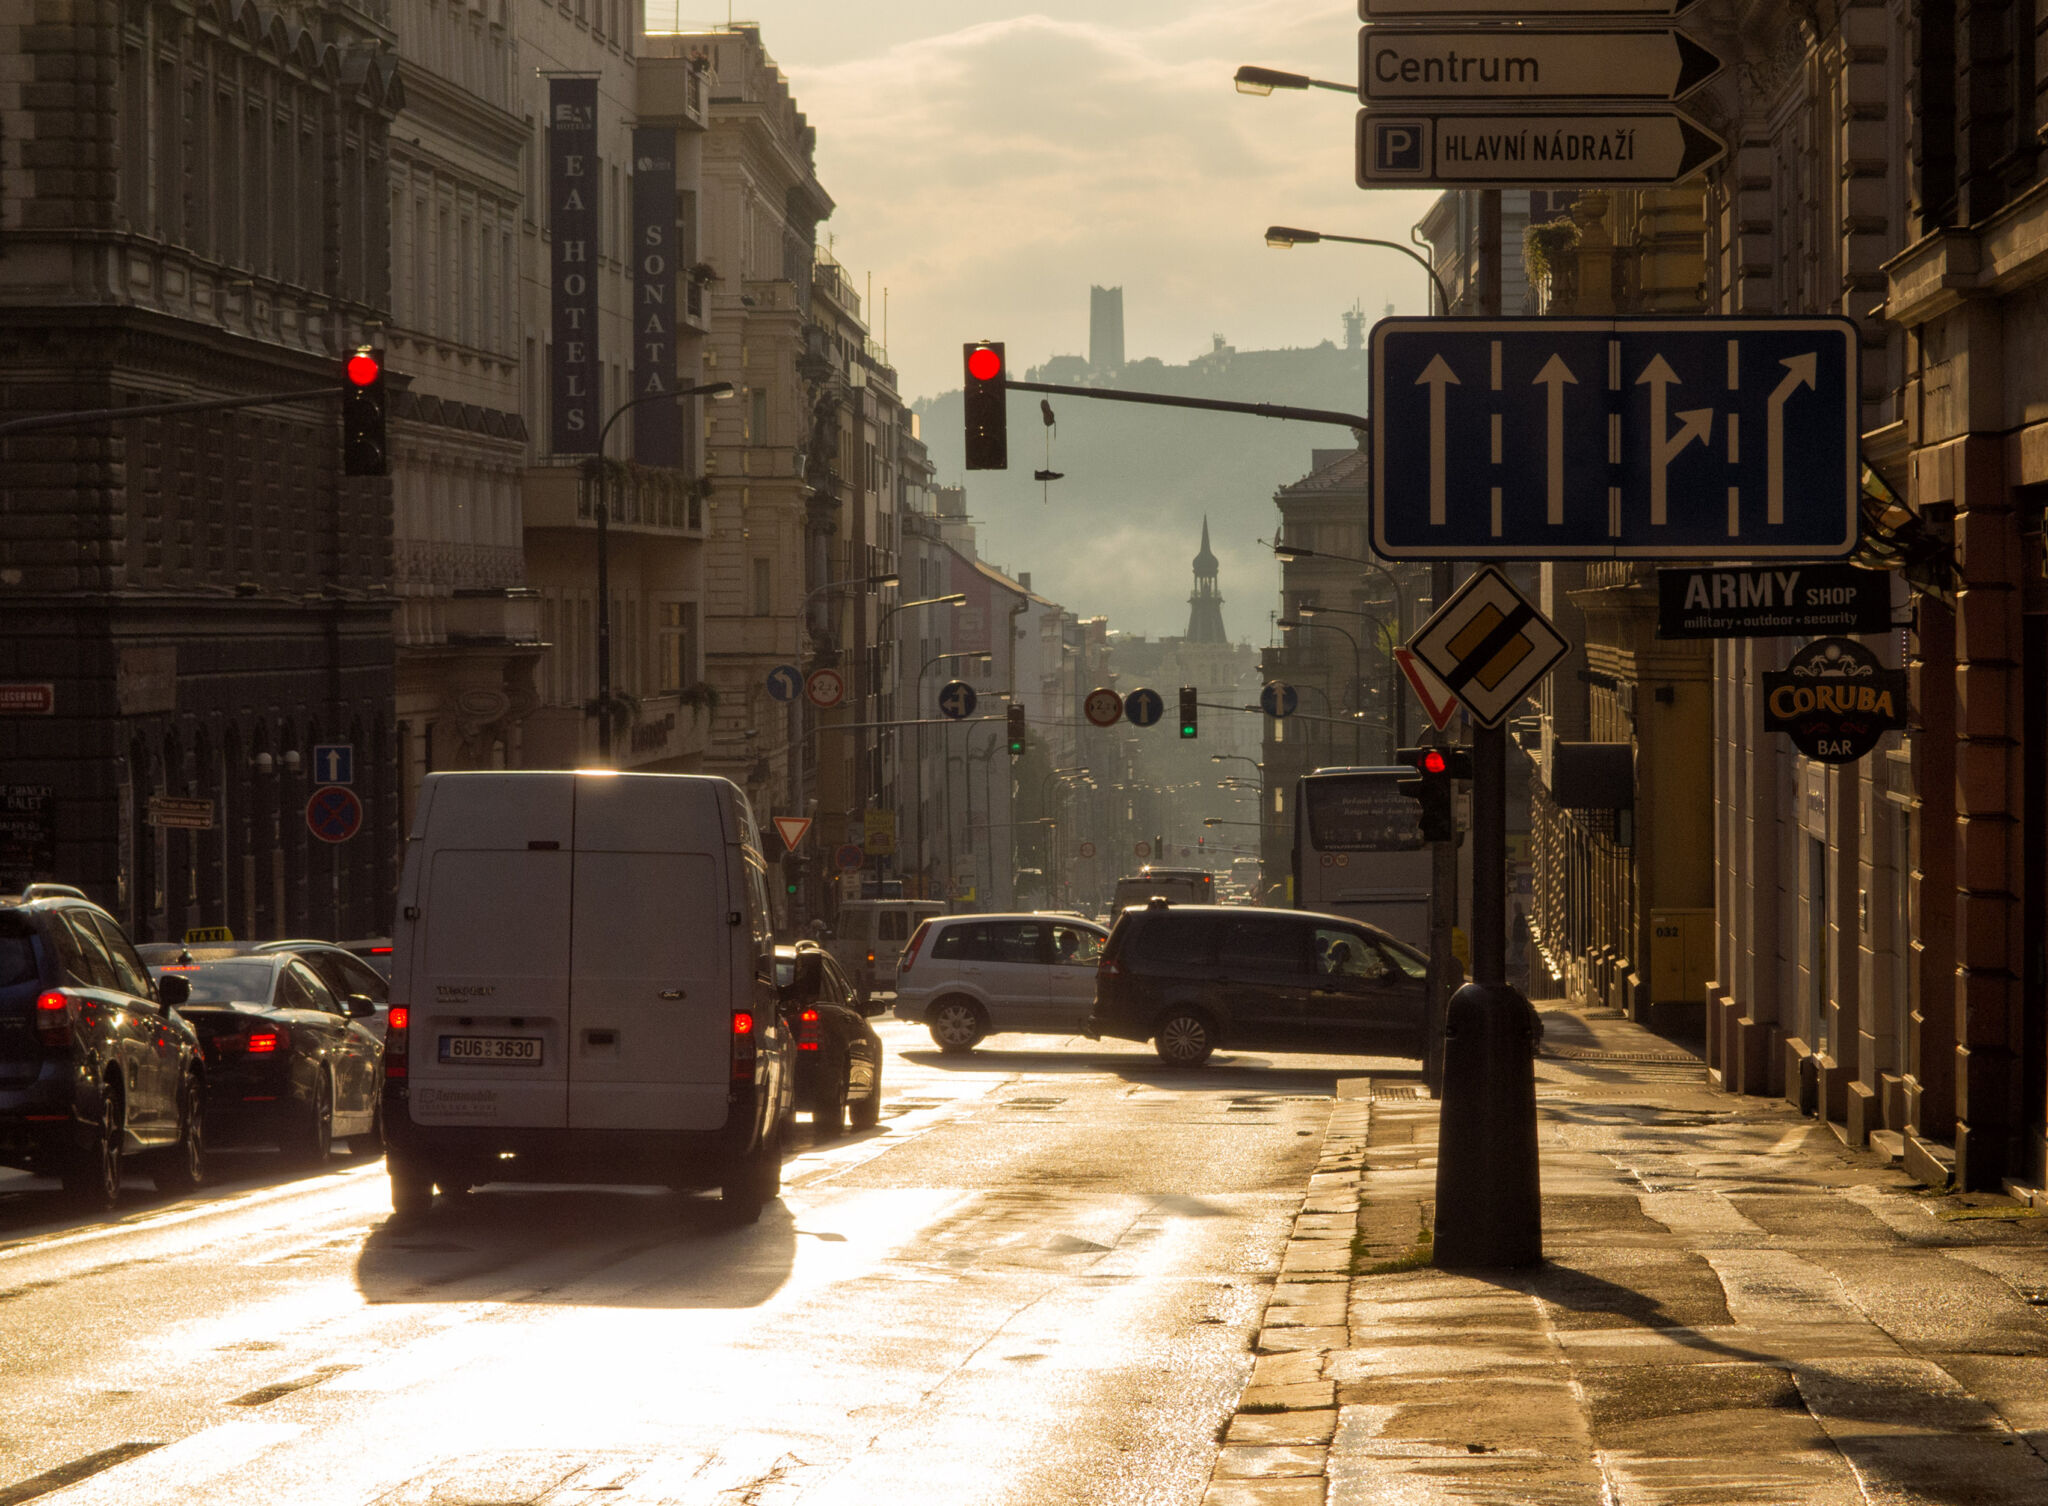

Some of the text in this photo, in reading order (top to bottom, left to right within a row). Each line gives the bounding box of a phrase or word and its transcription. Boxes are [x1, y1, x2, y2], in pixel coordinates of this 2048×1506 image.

[1375, 48, 1540, 83] Centrum
[1385, 129, 1637, 167] P HLAVNÍ NÁDRAŽÍ
[643, 225, 665, 392] SONATA
[563, 240, 586, 431] HOTELS
[1683, 571, 1857, 610] ARMY SHOP
[1684, 612, 1858, 629] military outdoor security
[1769, 685, 1896, 720] CORUBA
[1817, 738, 1853, 755] BAR
[189, 930, 225, 943] TAXI
[453, 1040, 534, 1058] 6U6 3630
